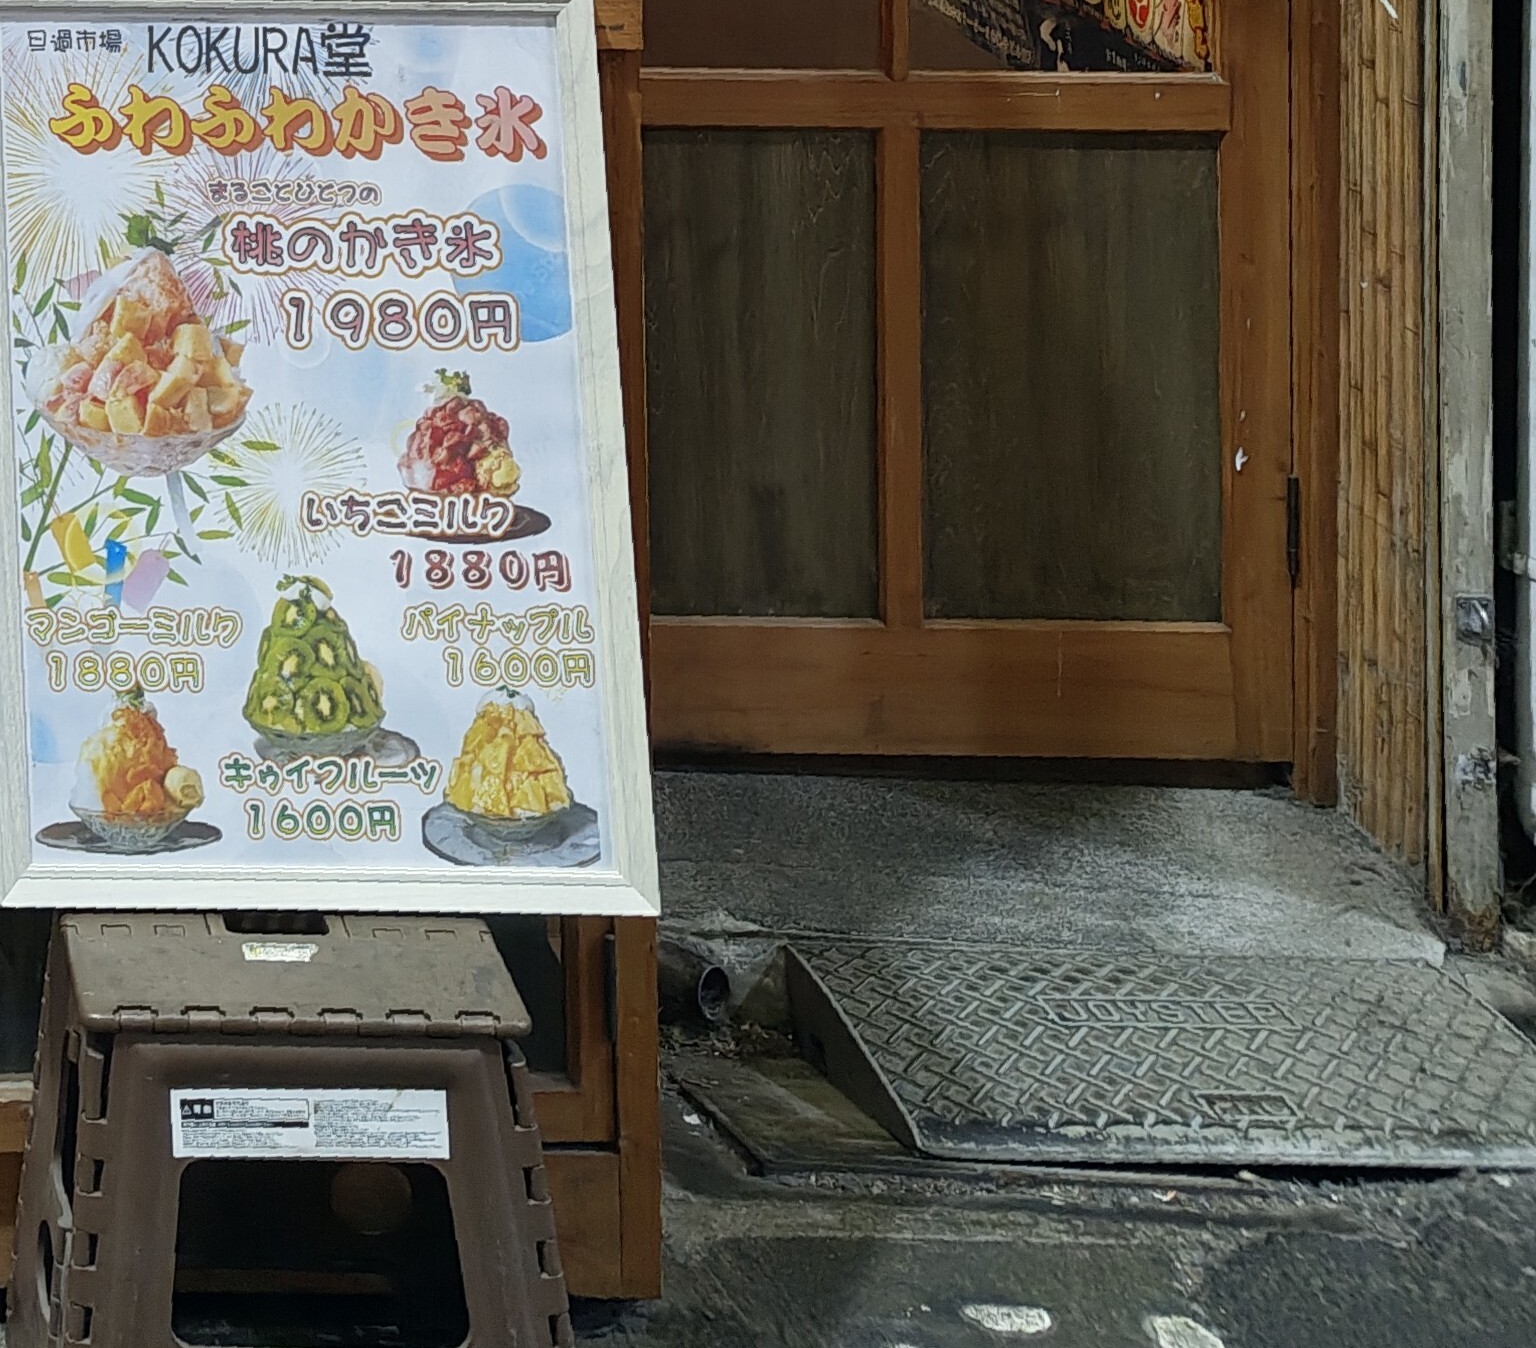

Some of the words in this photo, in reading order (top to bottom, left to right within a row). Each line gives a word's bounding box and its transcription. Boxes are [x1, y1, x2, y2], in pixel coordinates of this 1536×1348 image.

[147, 22, 374, 80] KOKURA堂
[48, 83, 549, 162] ふわふわかき氷
[227, 214, 499, 275] 桃のかき氷
[285, 292, 518, 349] 1980円
[304, 491, 512, 535] いちごミルク
[390, 549, 572, 591] 1880円
[27, 607, 241, 647] マンゴーミルク
[402, 605, 593, 641] パイナップル
[48, 653, 205, 692] 1880円
[446, 650, 595, 686] 1600円
[244, 801, 400, 841] 1600円
